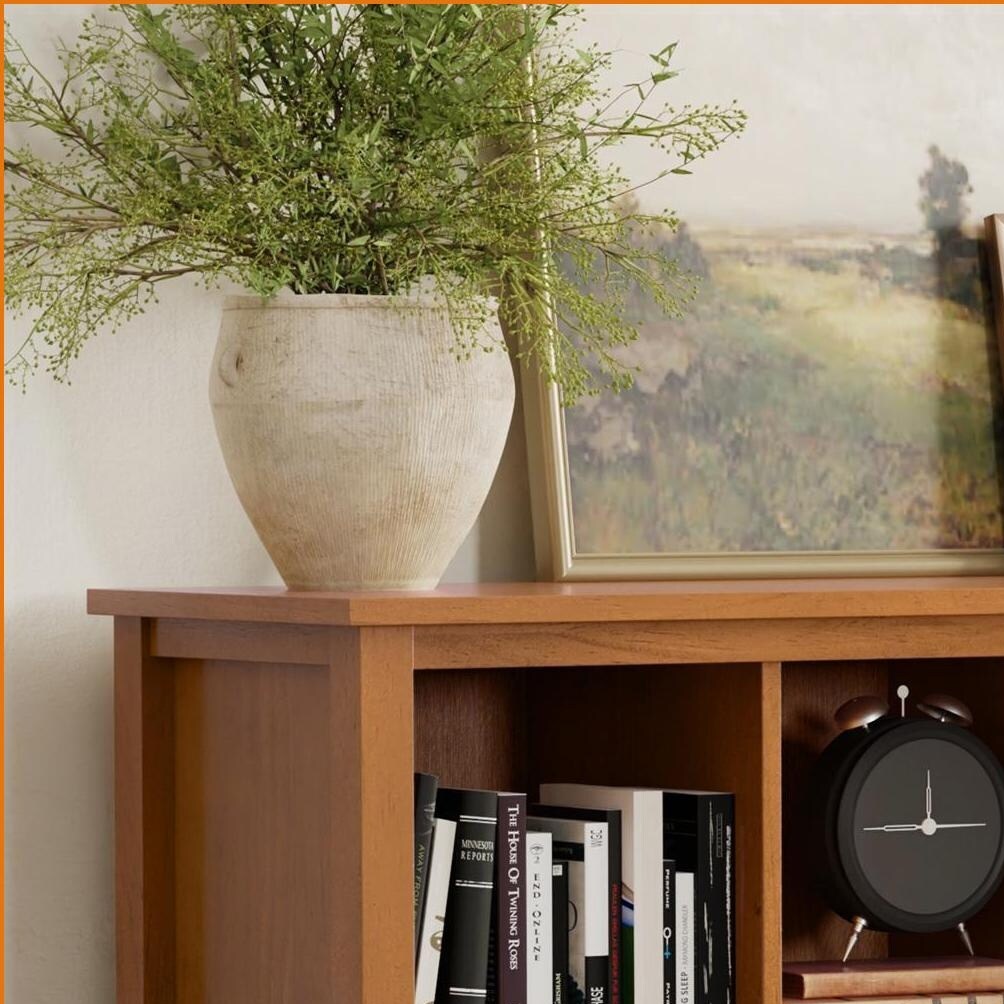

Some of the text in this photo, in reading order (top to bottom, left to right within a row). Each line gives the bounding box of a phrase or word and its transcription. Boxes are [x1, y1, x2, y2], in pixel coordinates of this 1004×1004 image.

[507, 803, 520, 827] THE
[460, 850, 494, 862] REPORTS
[507, 831, 520, 865] HOUSE
[507, 887, 520, 936] TWINING
[507, 939, 520, 970] ROSES
[680, 971, 689, 995] SLEEP
